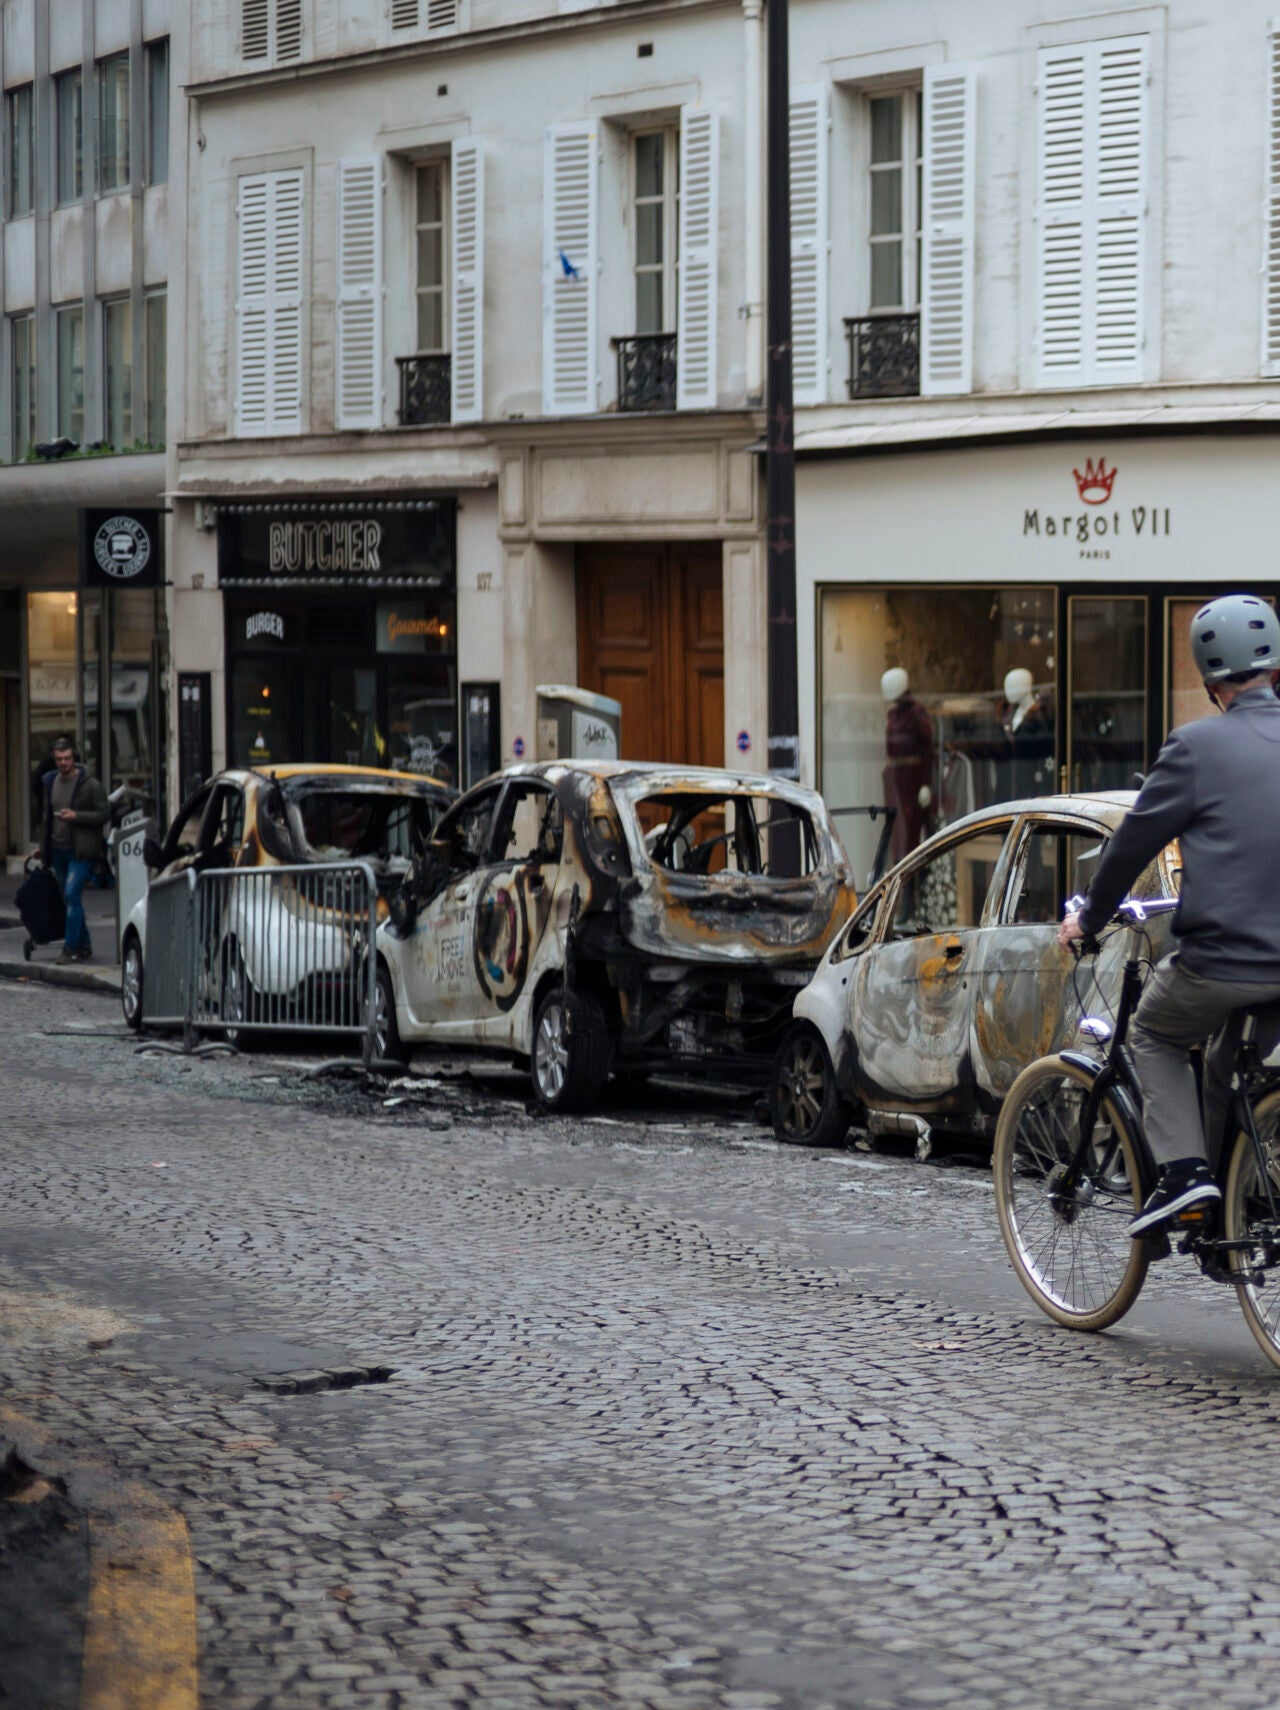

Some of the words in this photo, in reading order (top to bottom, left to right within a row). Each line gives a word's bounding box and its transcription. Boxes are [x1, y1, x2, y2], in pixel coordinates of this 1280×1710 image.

[1023, 508, 1120, 543] Margot
[1131, 505, 1171, 536] VII
[269, 519, 382, 572] BUTCHER
[1079, 550, 1111, 560] PARIS
[246, 611, 284, 640] BURGER
[121, 840, 142, 857] 06
